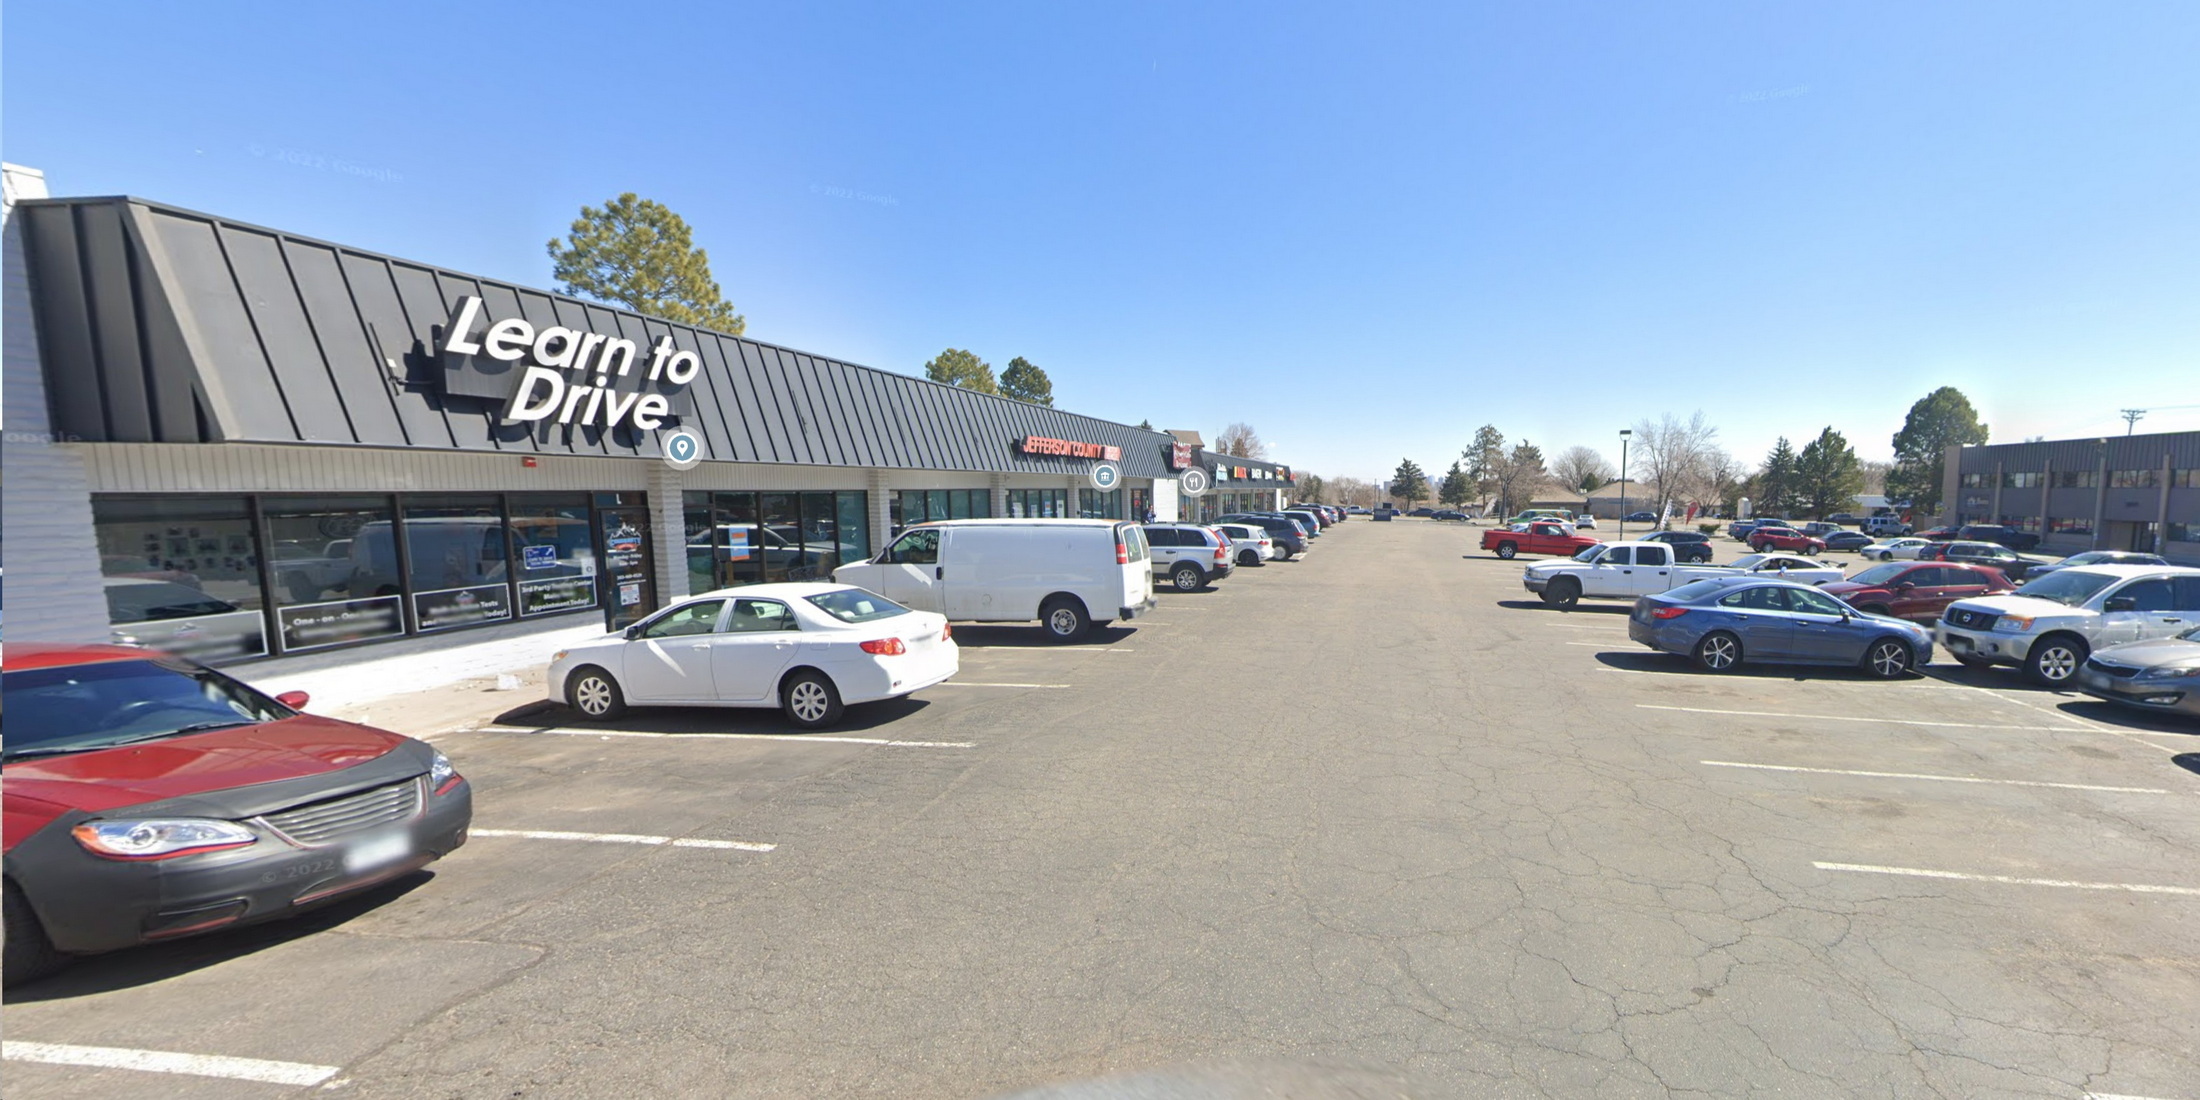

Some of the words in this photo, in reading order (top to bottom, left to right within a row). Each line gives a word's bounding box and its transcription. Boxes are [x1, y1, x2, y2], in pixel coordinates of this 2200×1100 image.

[446, 296, 636, 376] Learn
[648, 335, 700, 385] to
[508, 366, 669, 430] Drive
[1023, 435, 1072, 456] JEFFERSON
[1073, 441, 1102, 458] COUNTY
[480, 600, 499, 608] Tests
[529, 602, 570, 612] Appointment
[293, 617, 315, 625] One
